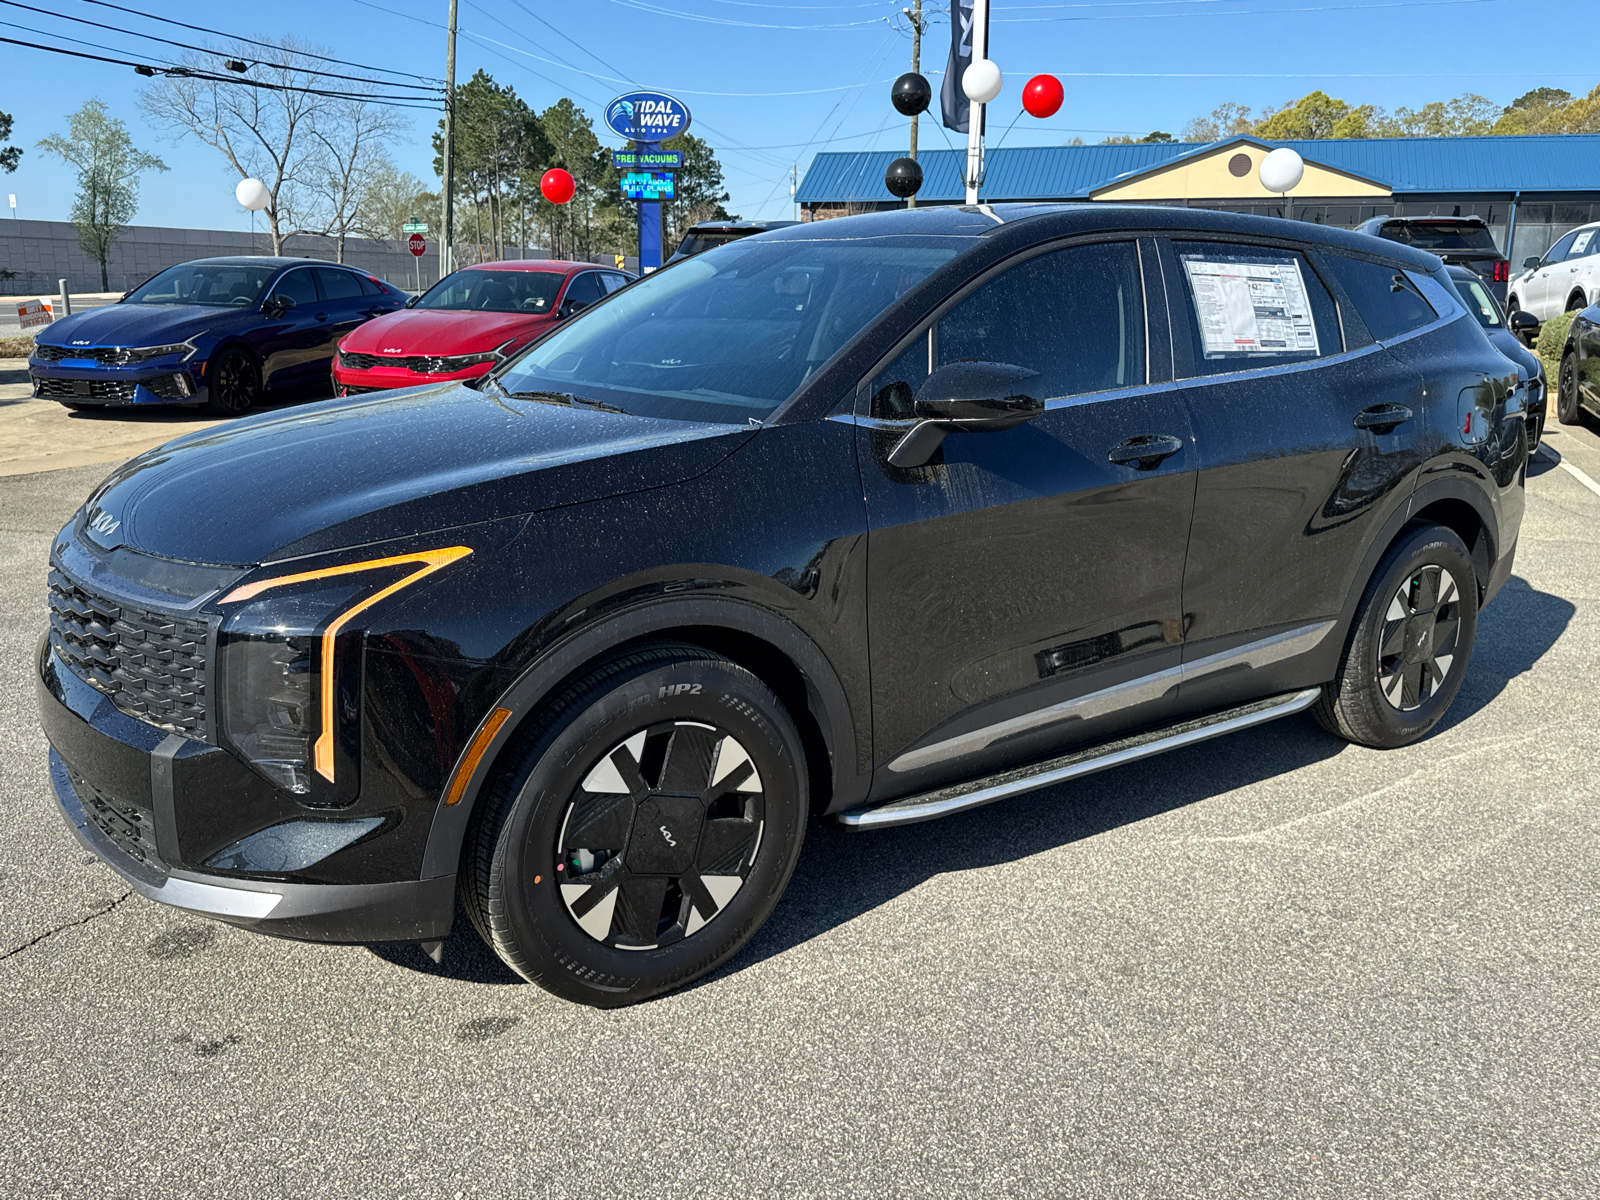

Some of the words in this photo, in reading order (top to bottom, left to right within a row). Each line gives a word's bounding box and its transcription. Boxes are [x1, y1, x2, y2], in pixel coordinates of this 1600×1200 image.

[634, 100, 673, 113] TIDAL
[640, 113, 681, 127] WAVE
[615, 154, 637, 163] FREE
[639, 154, 678, 164] VACUUMS
[409, 240, 425, 250] STOP
[657, 683, 703, 699] HP2
